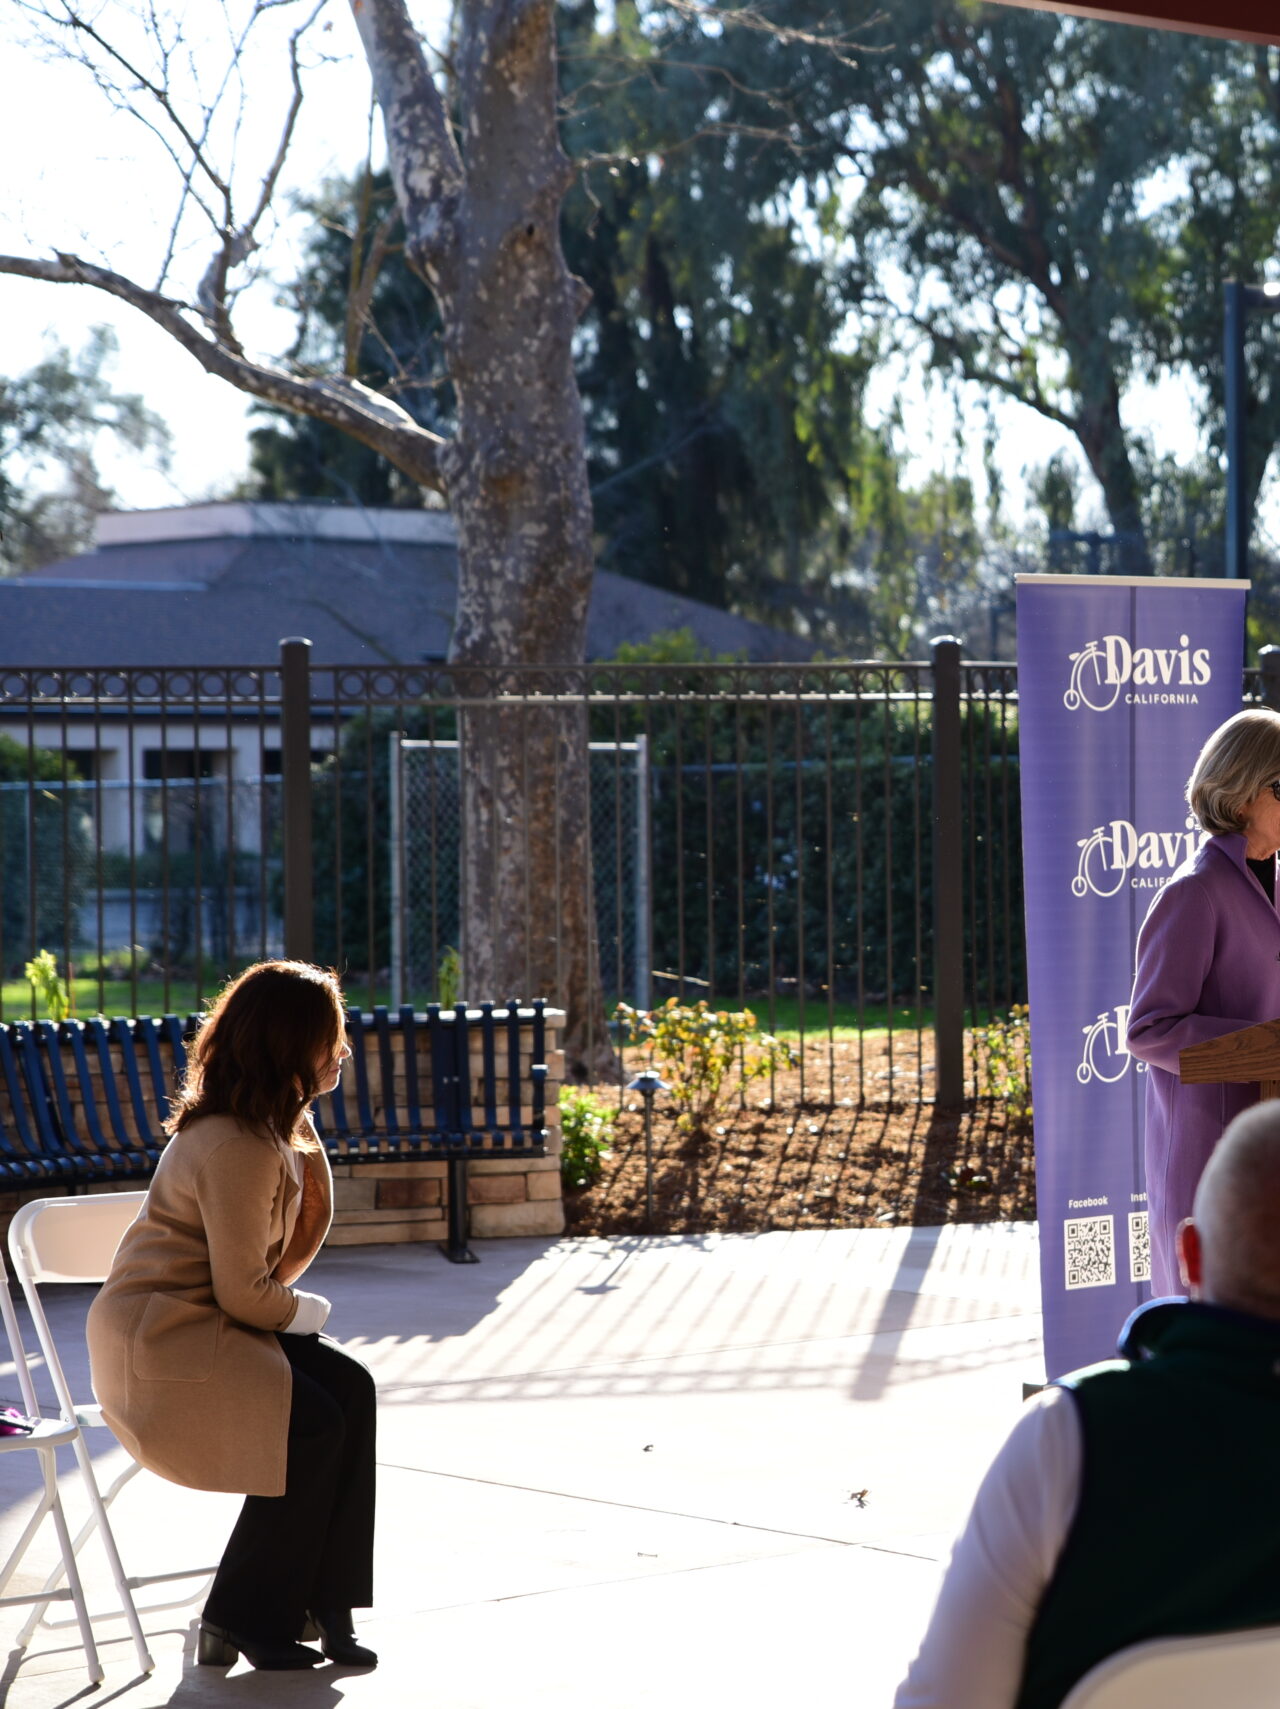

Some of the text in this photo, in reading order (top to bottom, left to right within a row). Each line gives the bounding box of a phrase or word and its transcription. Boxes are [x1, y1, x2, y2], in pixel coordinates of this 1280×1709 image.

[1102, 634, 1211, 685] Davis
[1125, 693, 1199, 704] CALIFORNIA
[1068, 1195, 1108, 1208] Facebook
